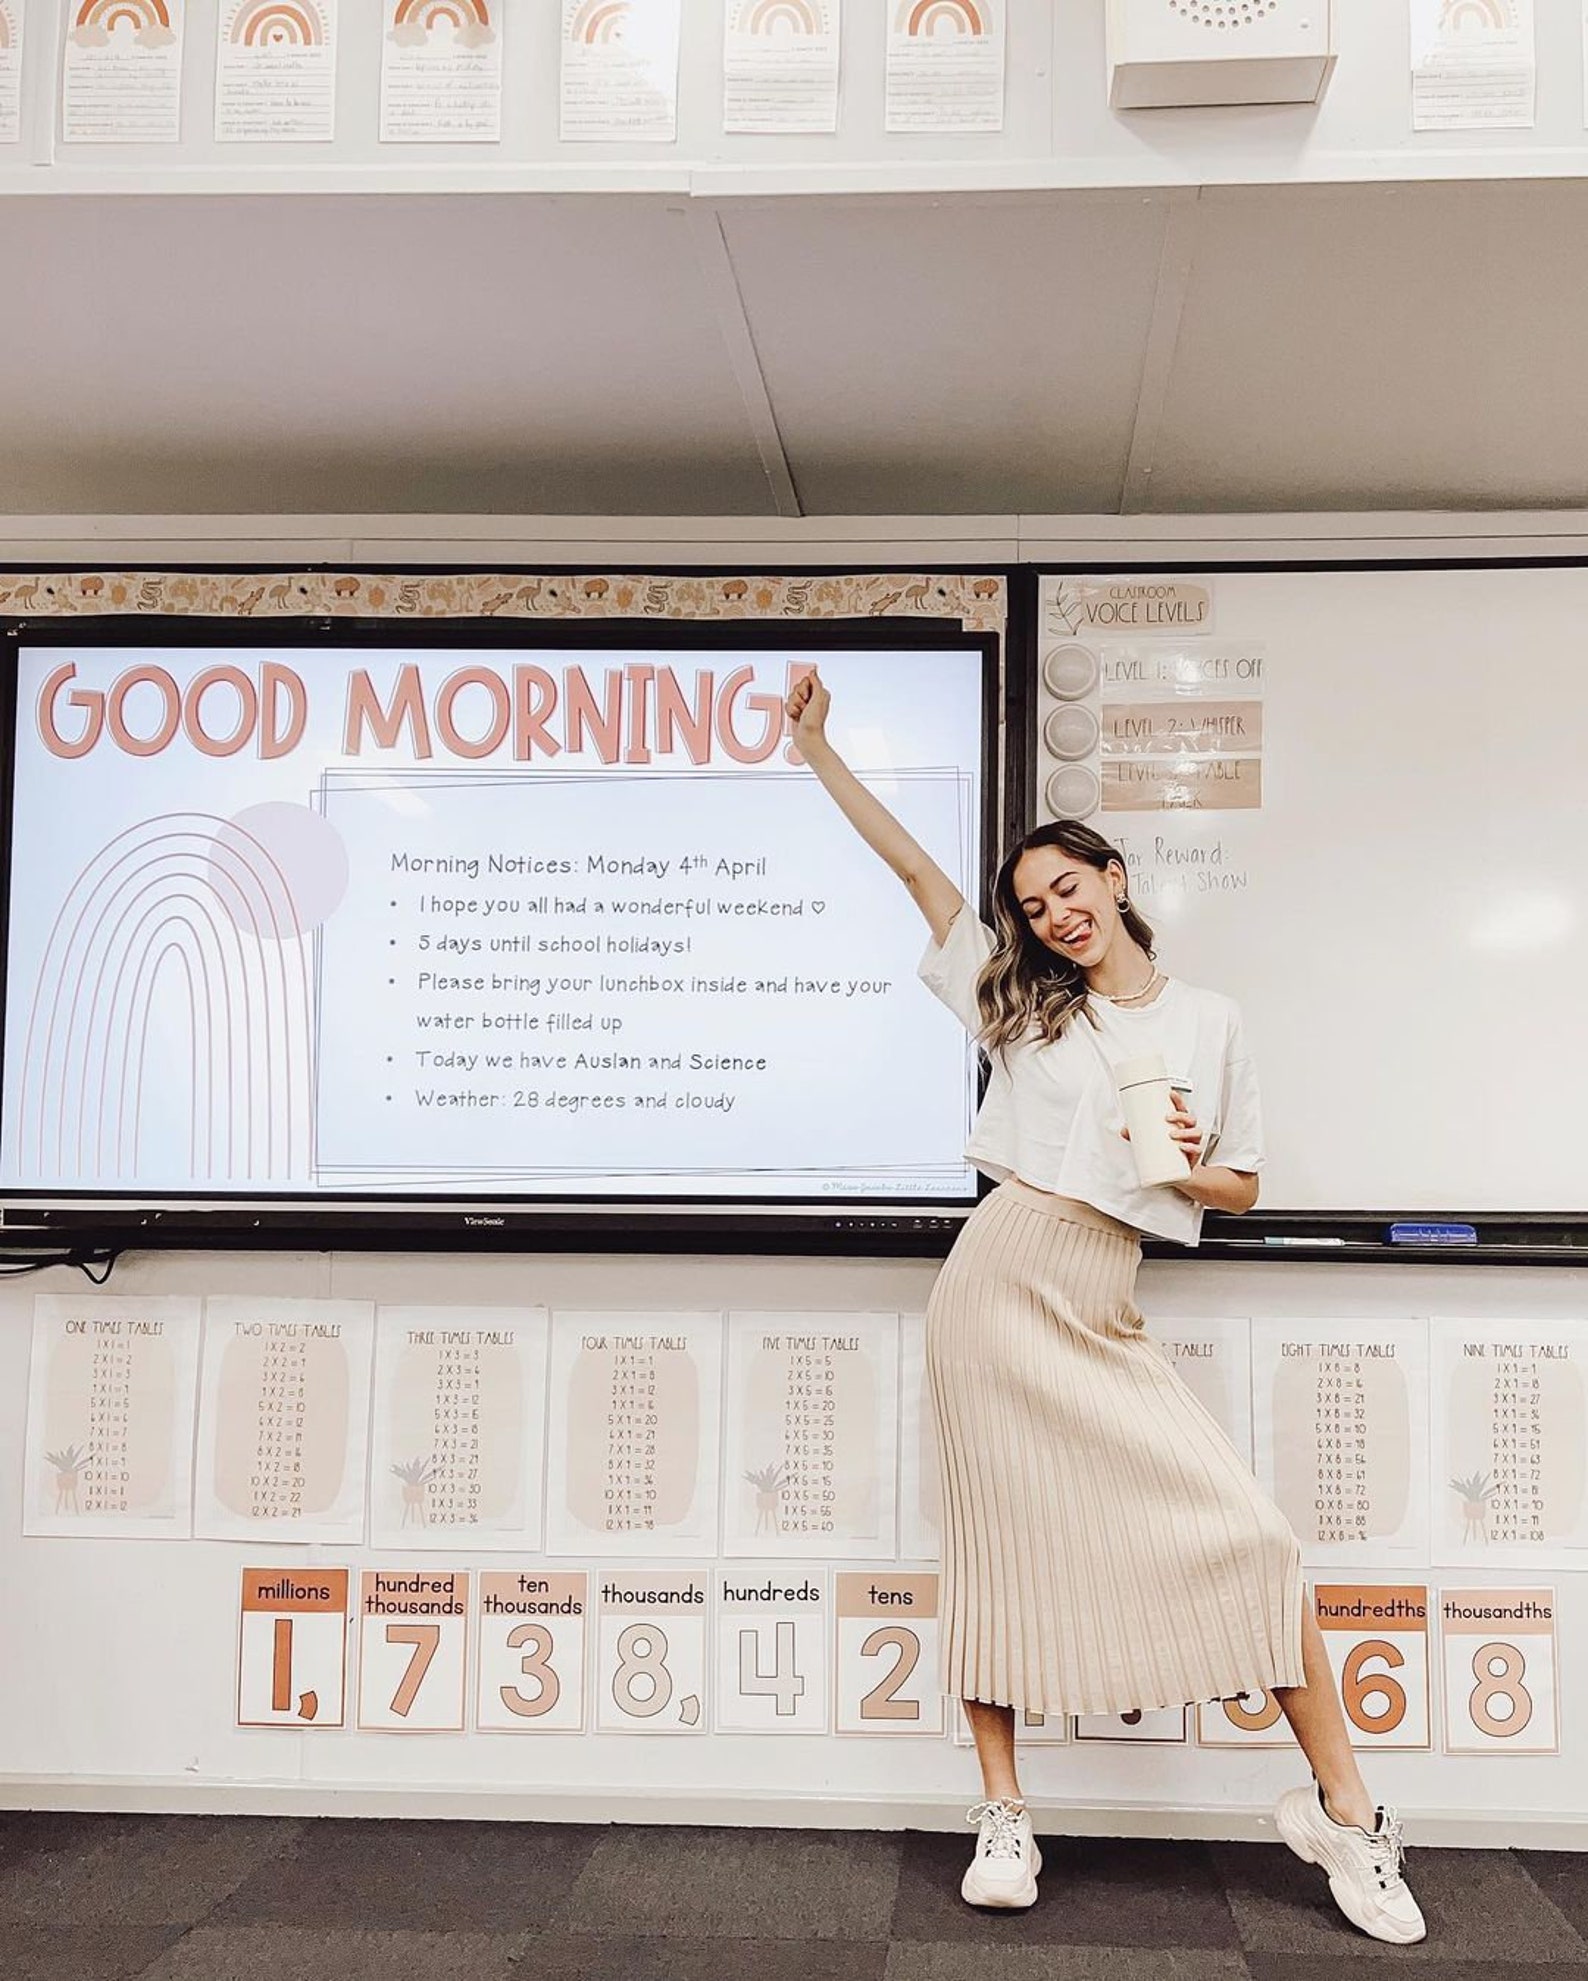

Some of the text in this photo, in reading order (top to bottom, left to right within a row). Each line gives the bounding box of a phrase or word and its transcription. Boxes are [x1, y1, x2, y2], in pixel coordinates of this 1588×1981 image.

[1109, 585, 1177, 599] CLASSROOM
[1086, 600, 1205, 623] VOICE LEVELS
[1104, 659, 1147, 681] LEVEL
[1235, 658, 1263, 679] OFF
[35, 660, 819, 766] GOOD MORNING!
[1113, 718, 1154, 738] LEVEL
[390, 853, 479, 879] Morning
[488, 854, 578, 874] Notices:
[587, 855, 670, 878] Monday
[715, 857, 767, 880] April
[1197, 871, 1248, 891] Show
[420, 896, 803, 918] I hope you all had a wonderful weekend
[418, 934, 691, 957] 5 days until school holidays!
[418, 972, 892, 997] Please bring your lunchbox inside and have your
[416, 1013, 622, 1035] water bottle filled up
[416, 1051, 767, 1071] Today we have Auslan and Science
[415, 1089, 736, 1113] Weather: 28 degrees and cloudy
[65, 1320, 164, 1335] ONE TIMES TABLES
[234, 1322, 342, 1338] TWO TIMES TABLES
[407, 1331, 514, 1345] THREE TIMES TABLES
[581, 1336, 687, 1350] FOUR TIMES TABLES
[762, 1336, 859, 1350] FIVE TIMES TABLES
[1174, 1343, 1214, 1357] TABLES
[1281, 1343, 1395, 1358] EIGHT TIMES TABLES
[1491, 1344, 1523, 1358] TIMES
[1529, 1345, 1569, 1359] TABLES
[257, 1583, 331, 1600] millions
[375, 1574, 455, 1594] hundred
[518, 1575, 549, 1593] ten
[601, 1583, 705, 1605] thousands
[723, 1580, 820, 1602] hundreds
[365, 1595, 465, 1616] thousands
[483, 1595, 583, 1616] thousands
[867, 1585, 914, 1606] tens
[1317, 1598, 1426, 1618] hundredths
[1443, 1602, 1552, 1620] thousandths
[385, 1624, 440, 1718] 7
[499, 1623, 561, 1718] 3
[739, 1621, 805, 1716] 4
[860, 1625, 921, 1720] 2
[1341, 1639, 1407, 1735] 6
[1468, 1642, 1533, 1738] 8
